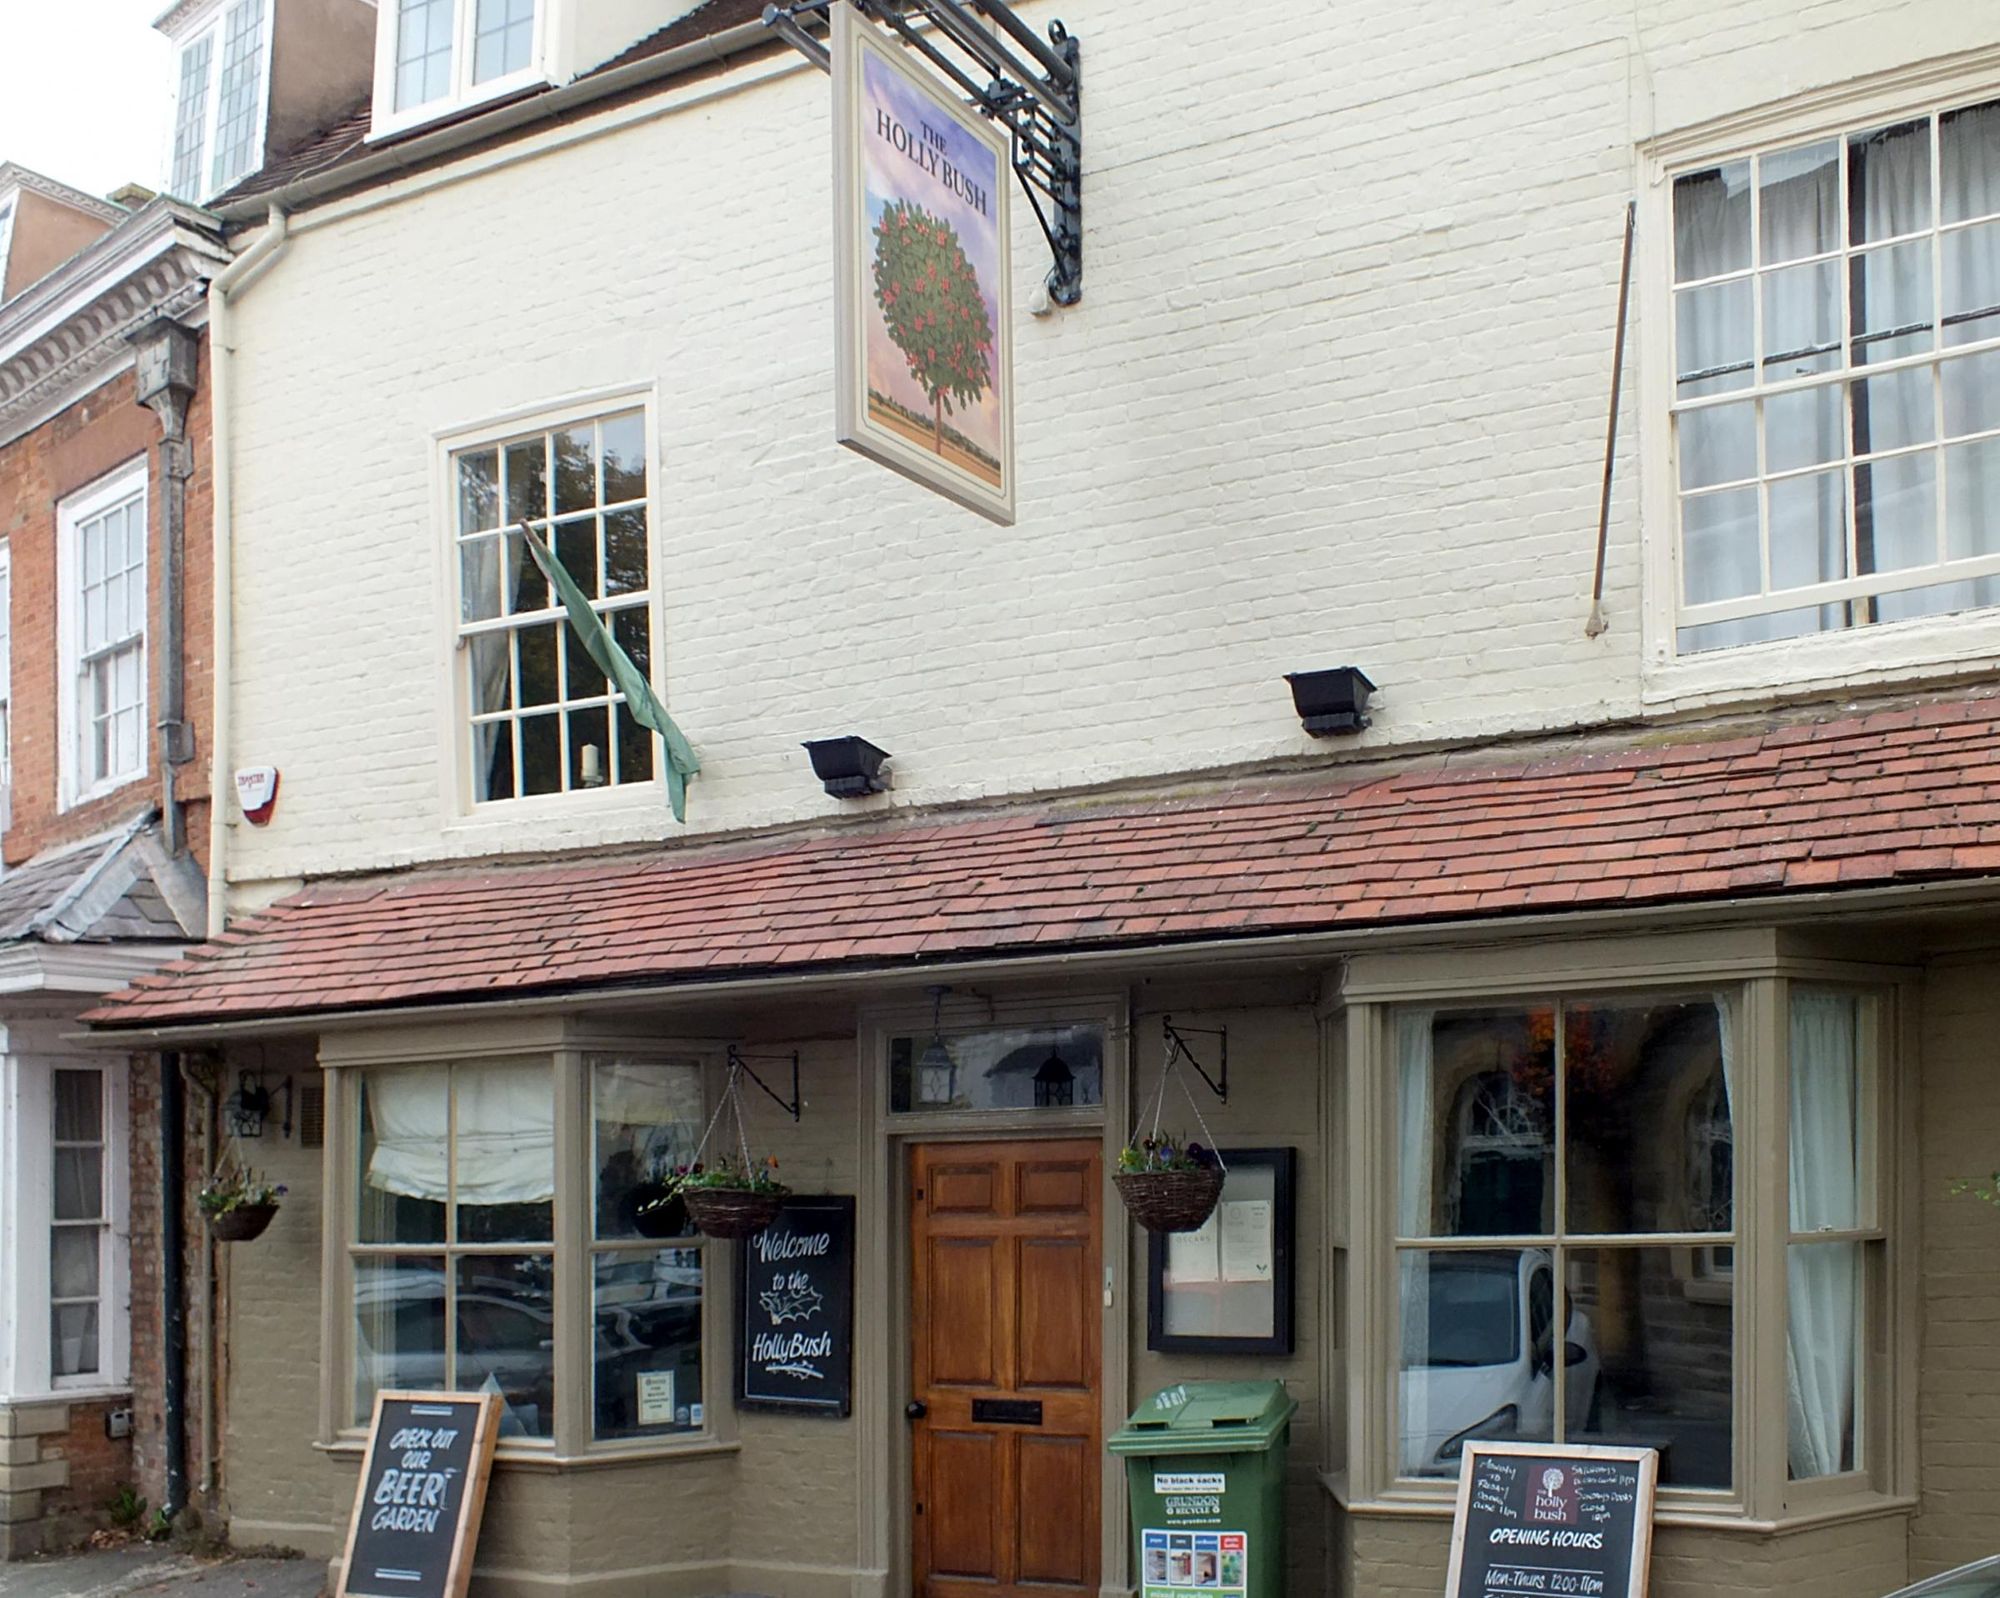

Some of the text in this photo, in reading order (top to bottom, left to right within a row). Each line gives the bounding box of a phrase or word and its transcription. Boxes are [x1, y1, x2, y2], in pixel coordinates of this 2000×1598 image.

[920, 120, 948, 155] THE
[876, 108, 988, 216] HOLLY BUSH
[753, 1229, 830, 1263] Welcome
[772, 1270, 809, 1291] to the
[389, 1427, 458, 1450] CHECK OUT
[401, 1450, 432, 1470] OUR
[373, 1468, 445, 1506] BEER
[1165, 1496, 1220, 1507] GRUNDON
[1535, 1495, 1568, 1509] holly
[371, 1507, 441, 1533] GARDEN
[1534, 1508, 1567, 1520] bush
[1489, 1528, 1603, 1549] OPENING HOURS
